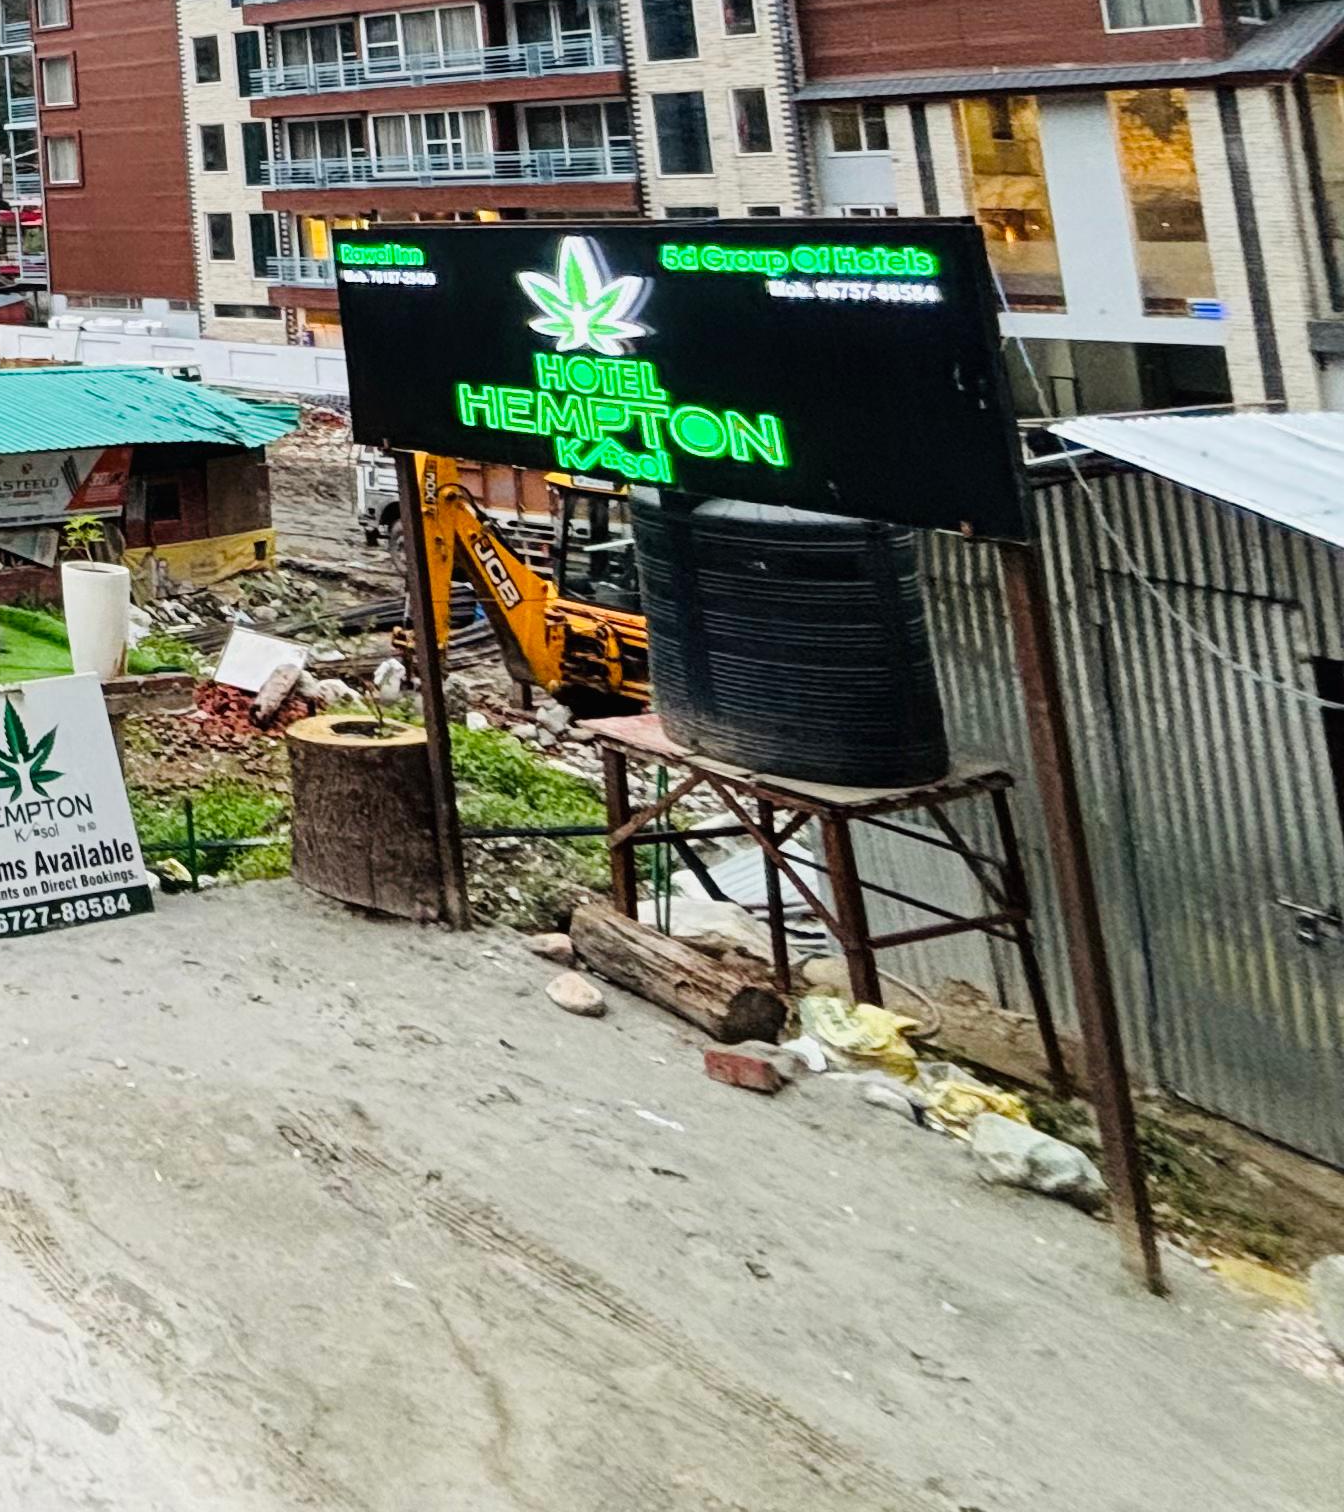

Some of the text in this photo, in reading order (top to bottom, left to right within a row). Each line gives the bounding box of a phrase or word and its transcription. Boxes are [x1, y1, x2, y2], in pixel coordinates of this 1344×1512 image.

[393, 244, 425, 266] Inn
[661, 244, 937, 277] 5d Group Of Hotels
[533, 352, 668, 402] HOTEL
[455, 382, 789, 468] HEMPTON
[473, 538, 521, 608] JCB
[35, 838, 134, 877] Available
[23, 885, 38, 898] on
[40, 877, 79, 895] Direct
